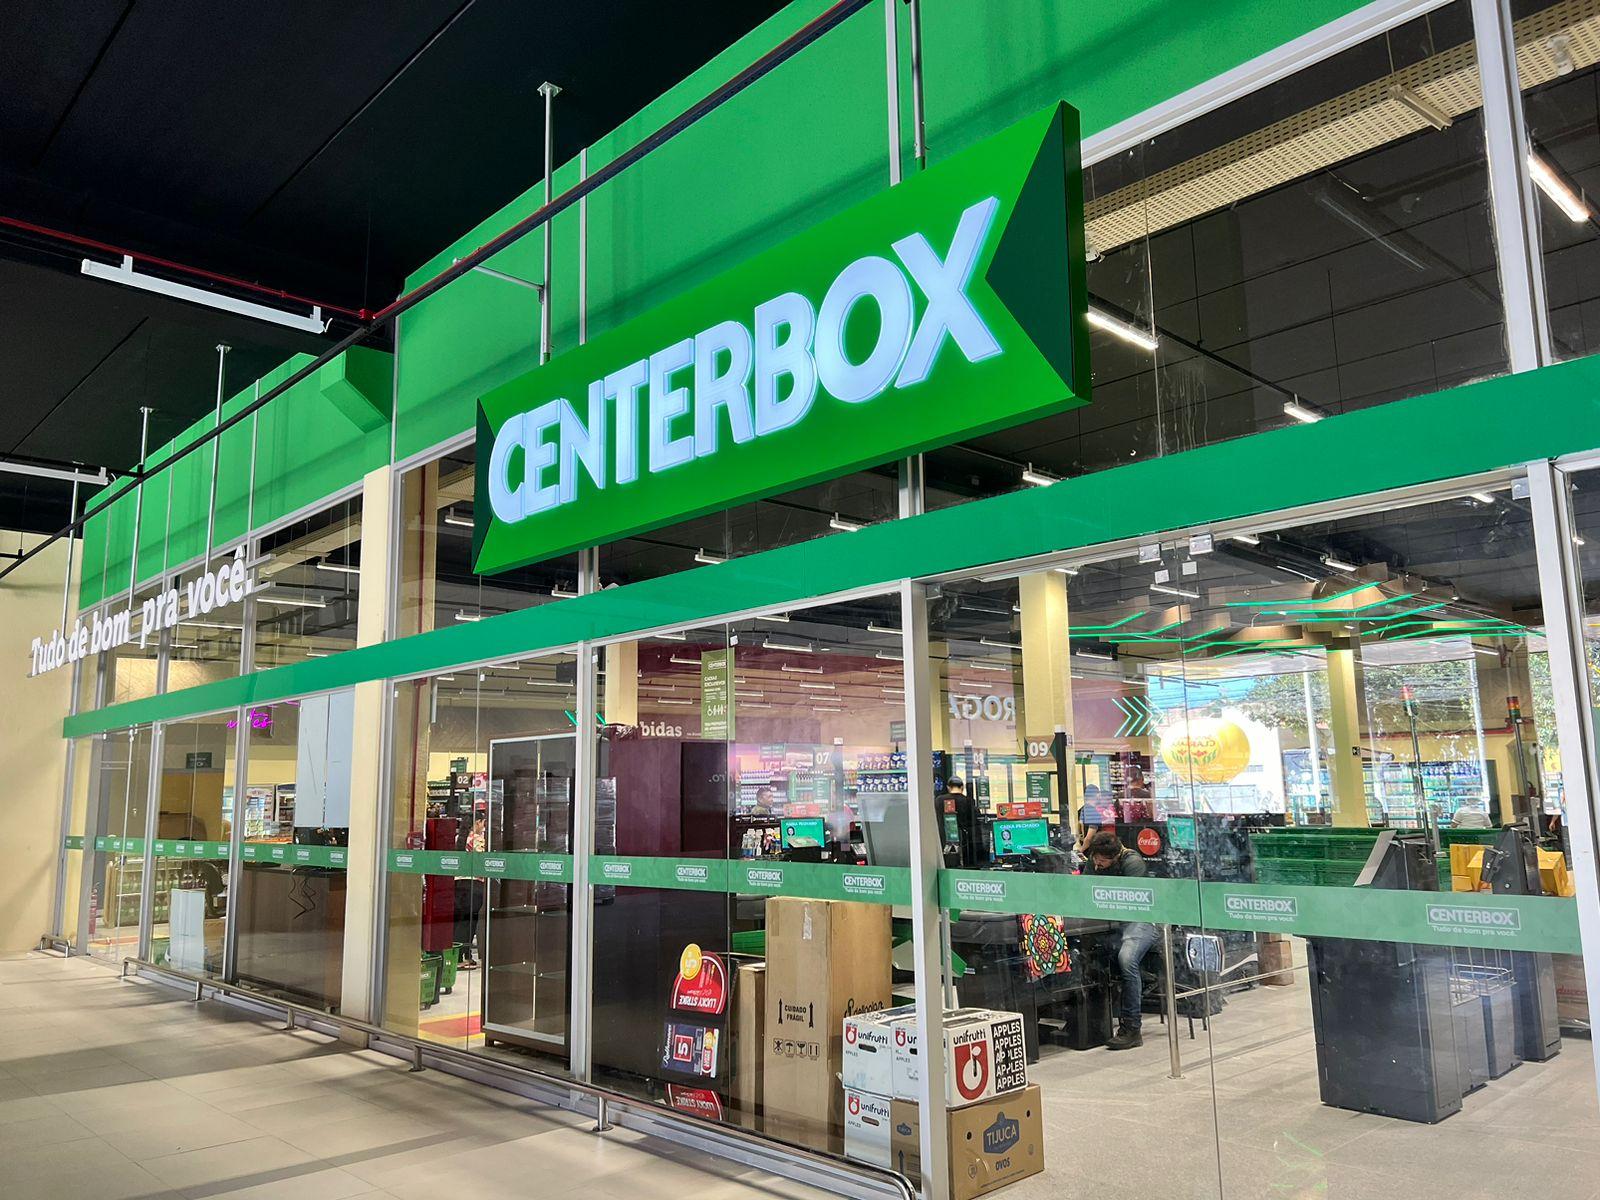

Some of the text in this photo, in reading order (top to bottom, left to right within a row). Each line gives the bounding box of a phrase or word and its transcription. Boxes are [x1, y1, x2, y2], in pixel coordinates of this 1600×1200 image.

[487, 195, 1002, 524] CENTERBOX
[31, 545, 253, 676] Tudo de bom pra você.
[640, 721, 683, 737] bidas
[1029, 741, 1049, 757] 09
[815, 751, 830, 765] 07
[457, 775, 469, 784] 02
[748, 870, 781, 881] CENTERBOX
[844, 875, 883, 888] CENTERBOX
[957, 881, 1003, 894] CENTERBOX
[1094, 889, 1151, 903] CENTERBOX
[1226, 897, 1293, 913] CENTERBOX
[1429, 908, 1515, 926] CENTERBOX
[1433, 925, 1451, 933] Tudo
[1463, 926, 1481, 935] bom
[784, 1004, 807, 1014] CUIDADO
[953, 1029, 986, 1046] unifrutti
[993, 1021, 1021, 1038] APPLES
[858, 1031, 888, 1045] unifrutti
[994, 1034, 1022, 1051] APPLES
[995, 1046, 1023, 1064] APLES
[997, 1072, 1025, 1090] APPLES
[861, 1103, 889, 1118] unifrutti
[986, 1124, 1017, 1146] TIJUCA
